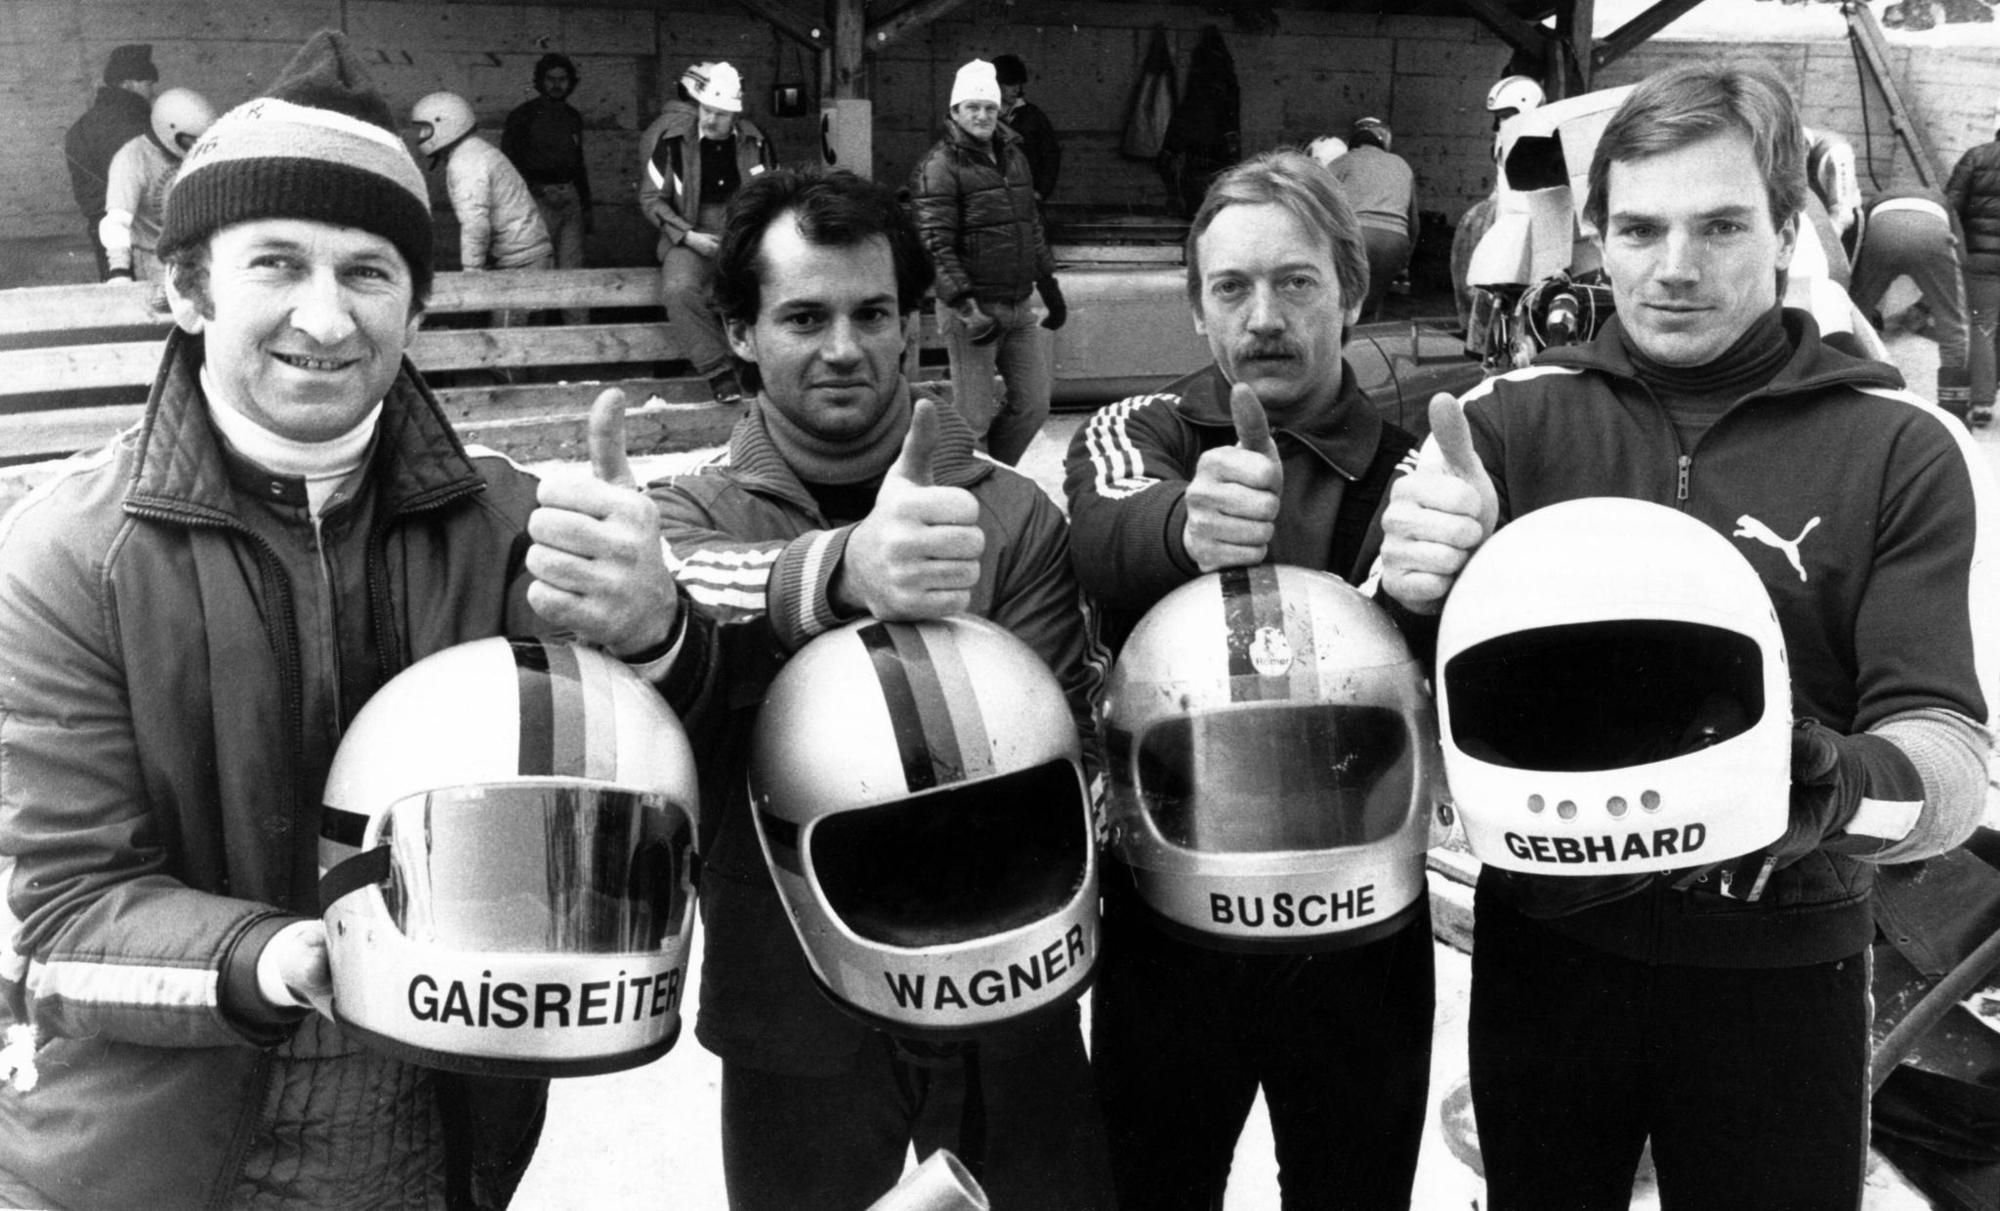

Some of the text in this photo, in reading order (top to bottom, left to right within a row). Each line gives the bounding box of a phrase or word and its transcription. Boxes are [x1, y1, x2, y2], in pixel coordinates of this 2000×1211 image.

[1504, 822, 1706, 864] GEBHARD
[1209, 884, 1375, 928] BUSCHE
[883, 922, 1085, 1010] WAGNER
